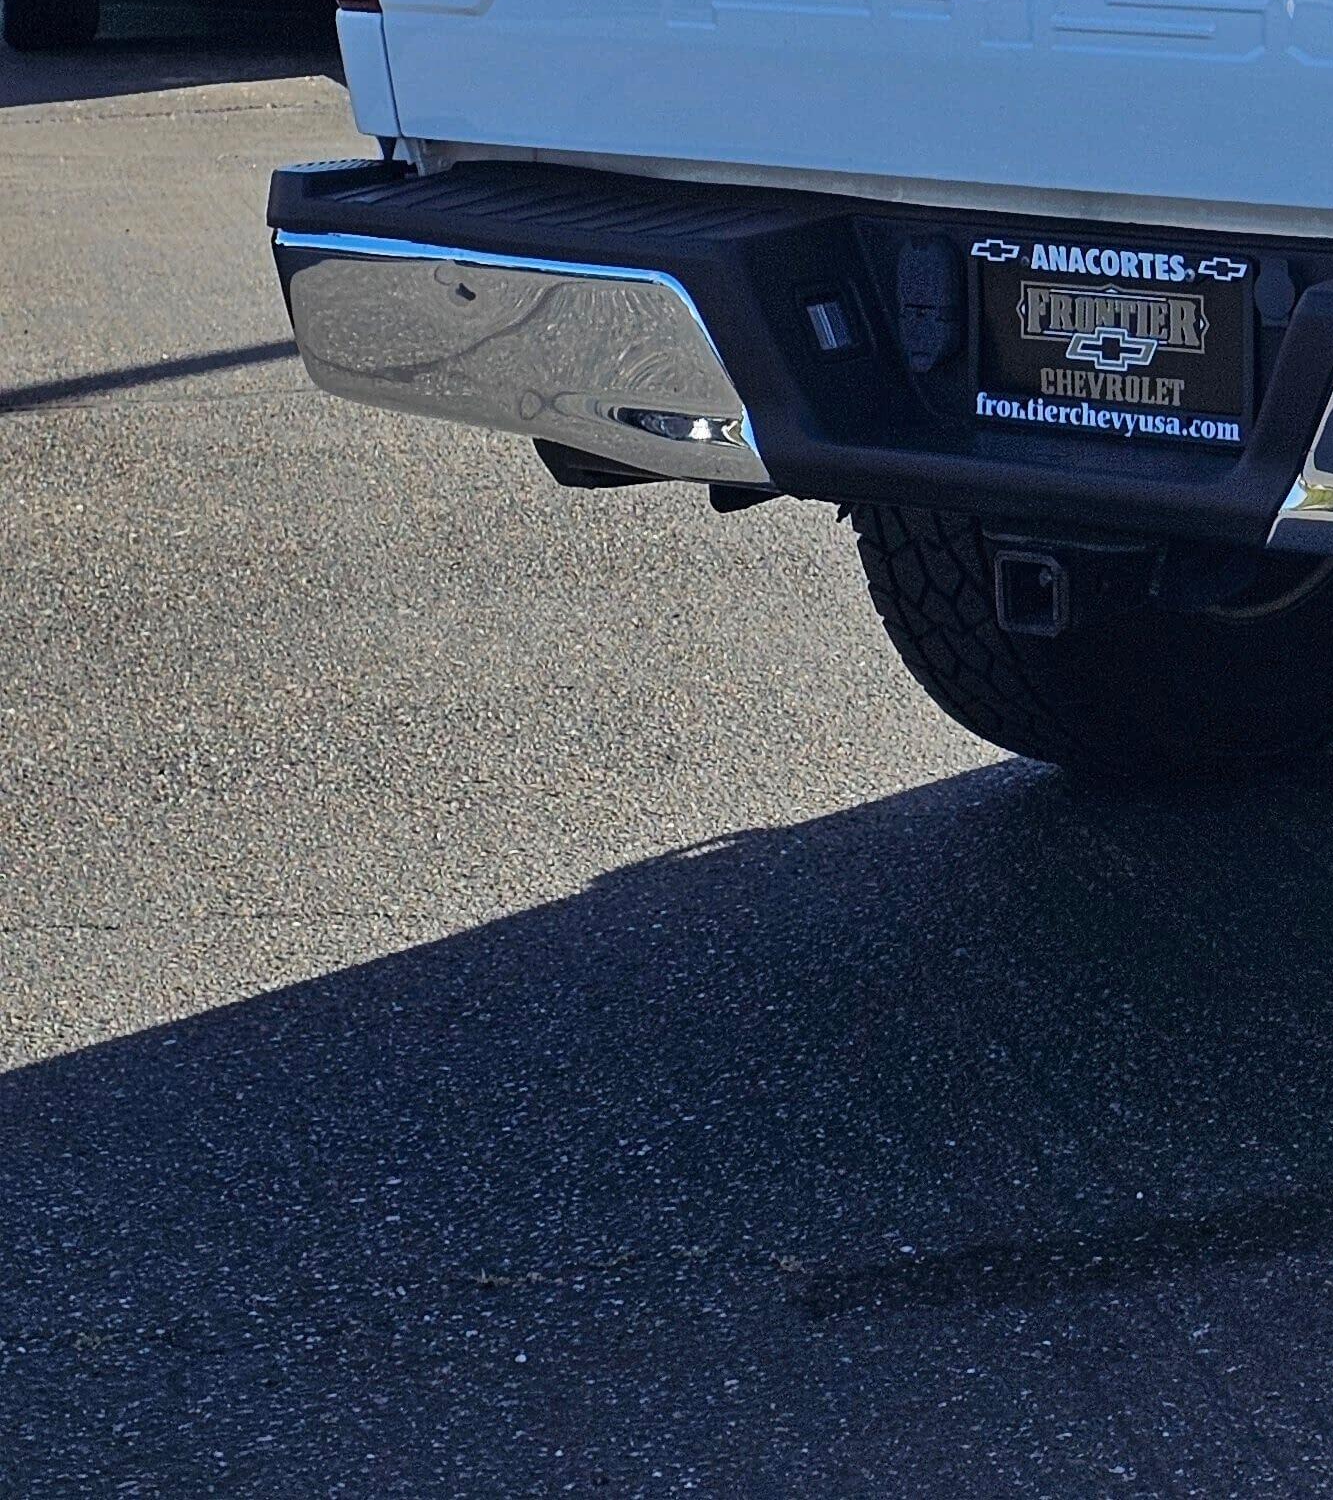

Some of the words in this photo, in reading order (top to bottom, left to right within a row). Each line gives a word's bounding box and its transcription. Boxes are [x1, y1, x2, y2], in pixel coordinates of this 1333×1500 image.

[1031, 244, 1186, 282] ANACORTES
[1027, 287, 1200, 346] FRONTIER
[1040, 367, 1185, 407] CHEVROLET
[975, 391, 1241, 442] frontierchevyusa.com
